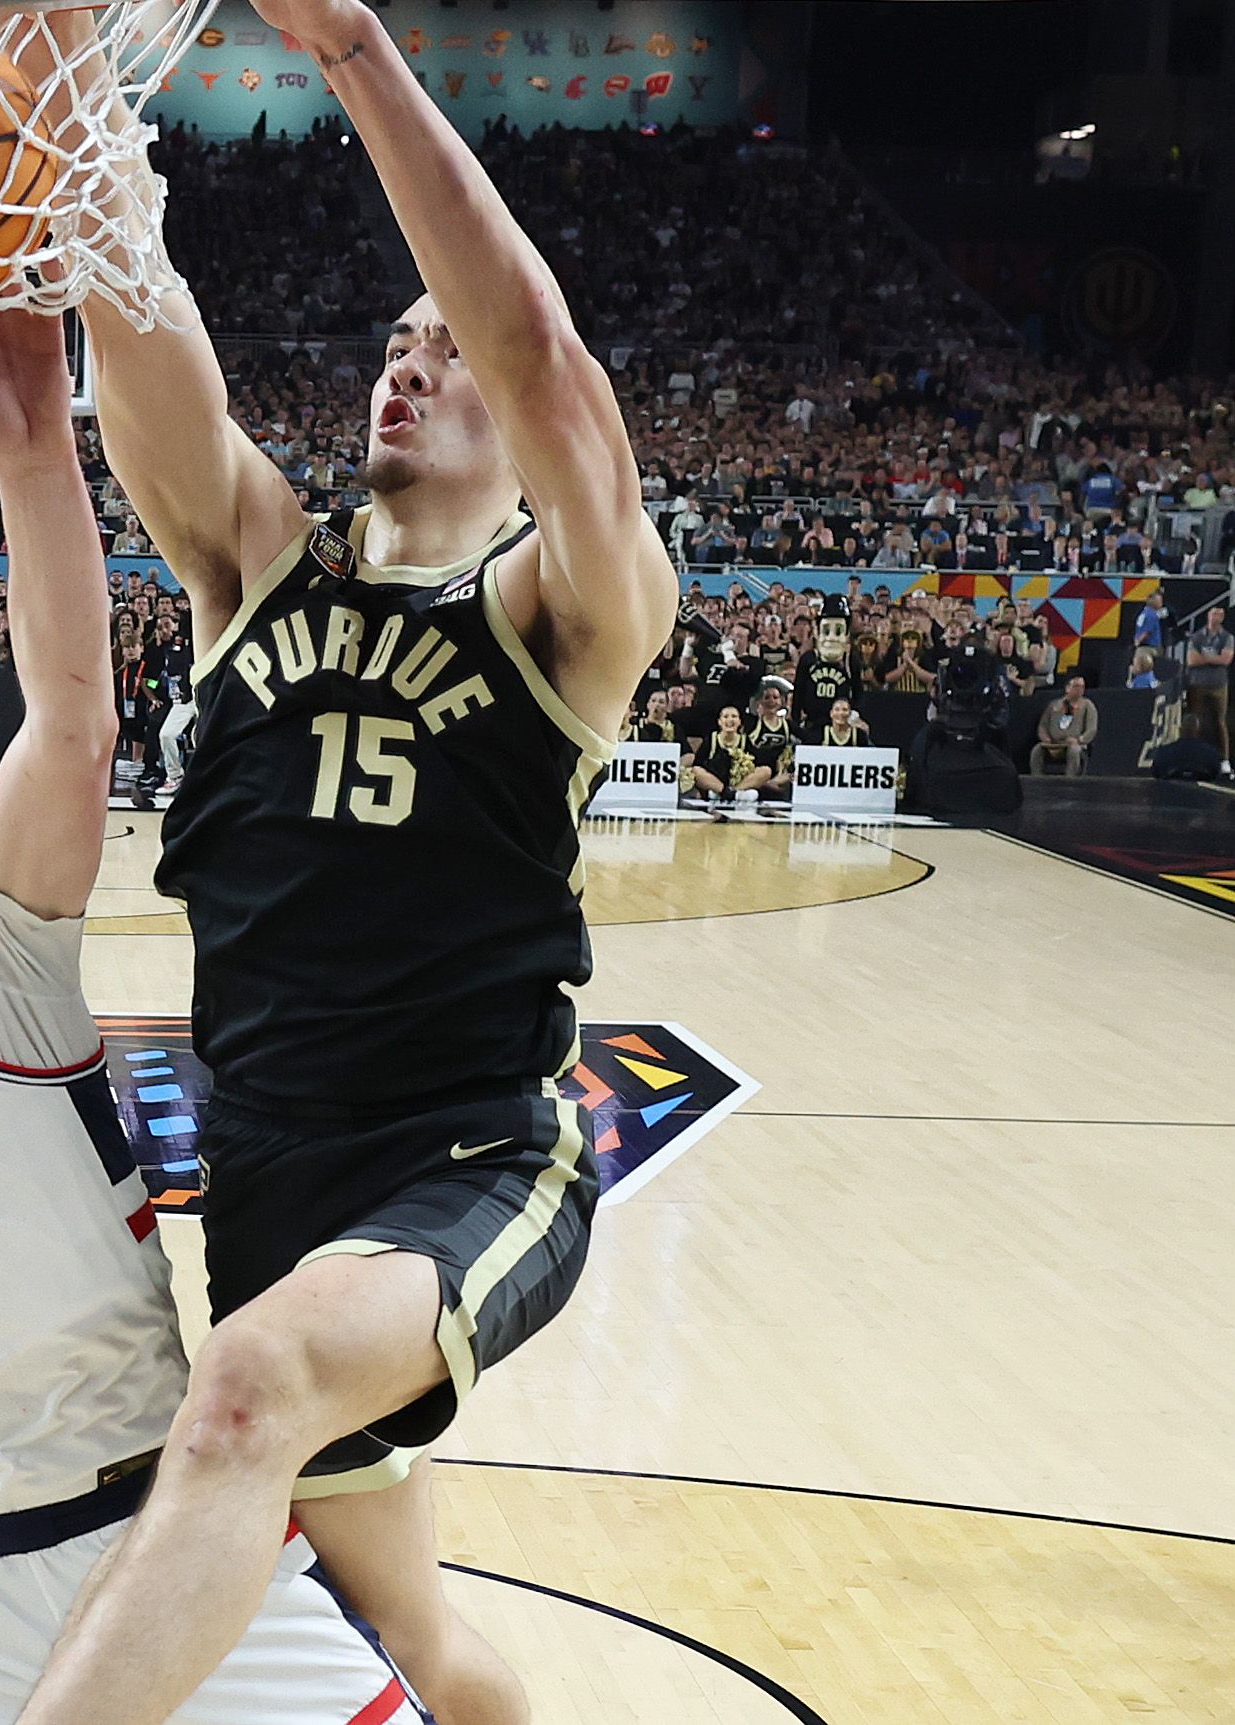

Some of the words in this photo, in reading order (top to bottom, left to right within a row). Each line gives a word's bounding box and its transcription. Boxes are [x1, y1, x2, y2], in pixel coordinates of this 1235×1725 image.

[233, 605, 495, 736] PURDUE
[817, 682, 836, 698] 00
[309, 711, 417, 827] 15
[612, 759, 676, 783] ILERS
[797, 763, 895, 789] BOILERS
